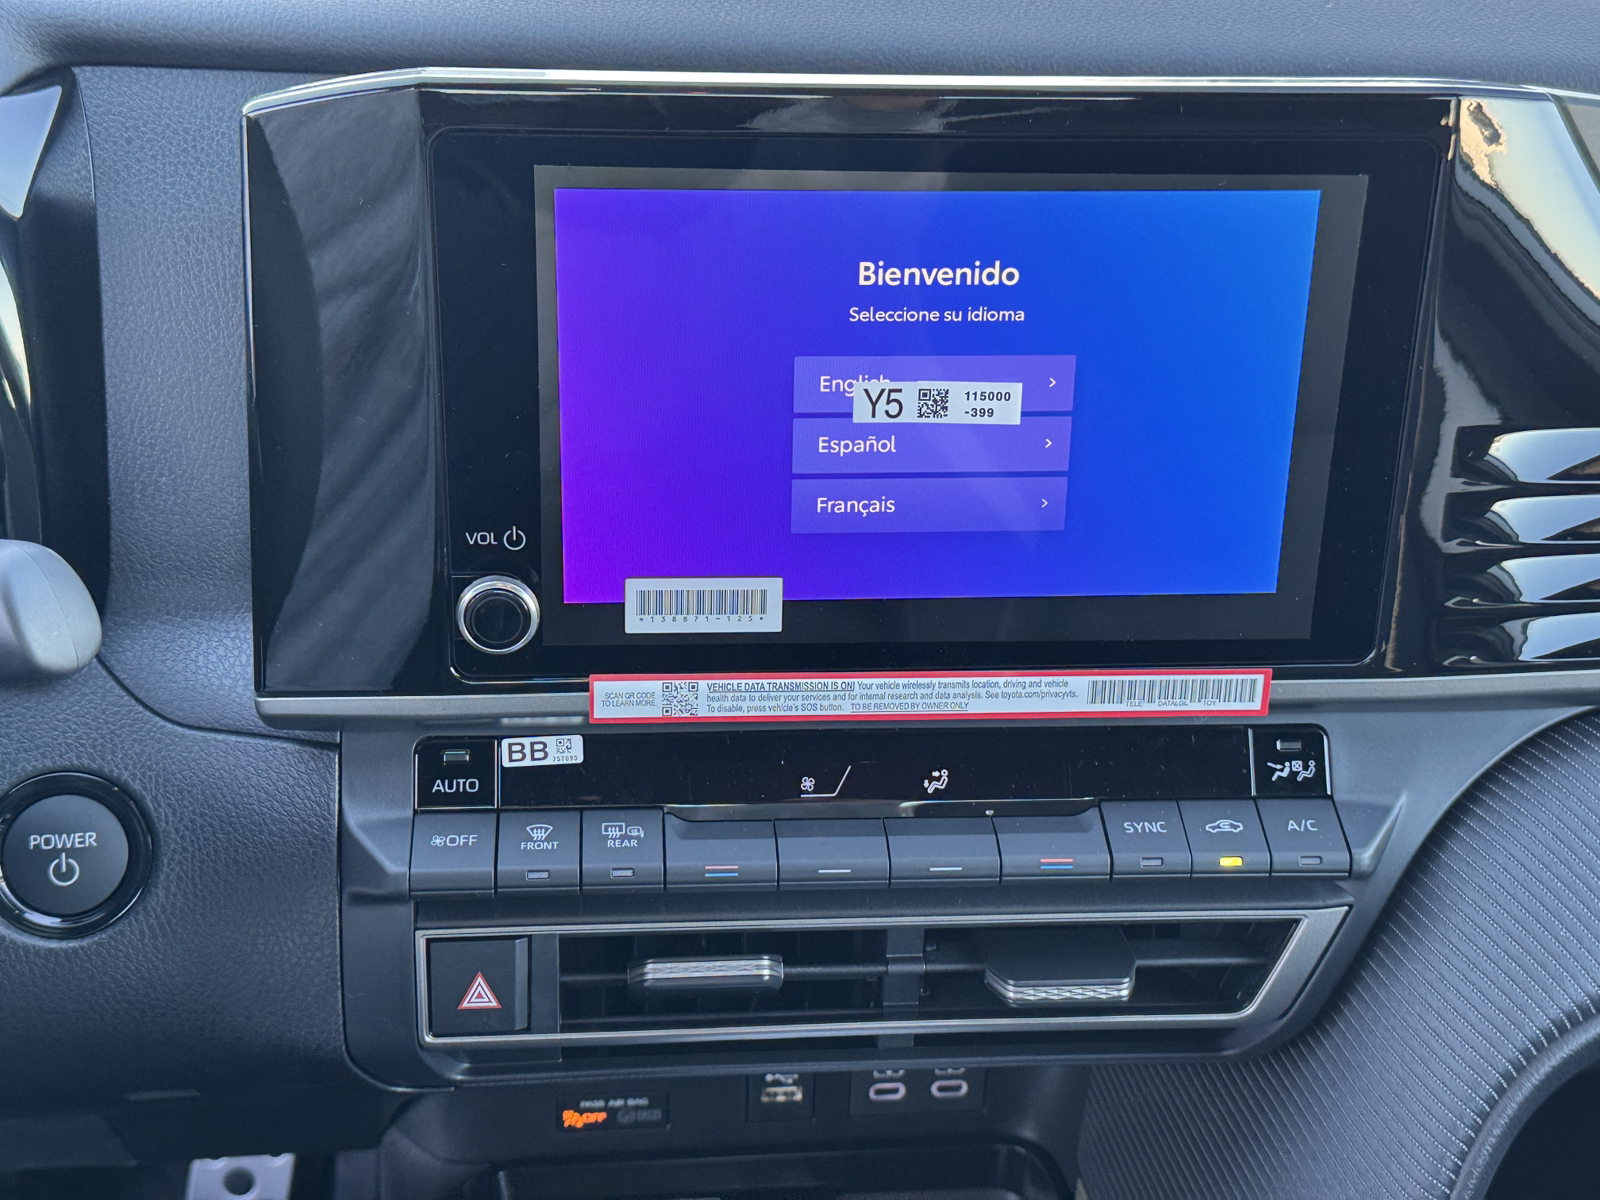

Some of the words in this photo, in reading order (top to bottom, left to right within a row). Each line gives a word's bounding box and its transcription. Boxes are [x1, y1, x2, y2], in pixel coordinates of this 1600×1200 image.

[858, 260, 1020, 286] Bienvenido
[848, 306, 940, 322] Seleccione
[943, 310, 962, 322] su
[967, 306, 1025, 322] idioma
[964, 391, 1012, 402] 115000
[863, 388, 904, 419] Y5
[964, 407, 995, 418] -399
[818, 435, 897, 457] Español
[816, 496, 896, 517] Français
[465, 532, 498, 545] VOL
[706, 682, 743, 692] VEHICLE
[744, 682, 766, 691] DATA
[766, 681, 829, 691] TRANSMISSION
[831, 681, 839, 690] IS
[857, 681, 874, 690] Your
[875, 680, 900, 690] vehicle
[902, 680, 937, 691] wirelessly
[937, 679, 970, 689] transmits
[971, 679, 1002, 690] location,
[1002, 679, 1027, 690] driving
[1028, 679, 1042, 688] and
[1044, 678, 1069, 688] vehicle
[604, 692, 624, 700] SCAN
[624, 692, 635, 700] QR
[706, 693, 729, 702] health
[730, 693, 747, 702] data
[748, 694, 756, 702] to
[758, 693, 781, 702] deliver
[783, 694, 800, 704] your
[801, 693, 831, 701] services
[832, 693, 846, 701] and
[847, 692, 858, 701] for
[860, 692, 886, 701] internal
[887, 691, 918, 700] research
[920, 691, 933, 700] and
[934, 691, 951, 699] data
[984, 690, 999, 699] See
[706, 704, 715, 713] To
[717, 703, 745, 714] disable,
[746, 705, 767, 714] press
[768, 703, 799, 712] vehicle's
[800, 703, 818, 711] SOS
[851, 703, 861, 711] TO
[873, 702, 910, 711] REMOVED
[910, 702, 921, 710] BY
[921, 702, 949, 710] OWNER
[949, 701, 970, 710] ONLY
[507, 741, 549, 763] BB
[432, 778, 479, 793] AUTO
[1124, 821, 1167, 834] SYNC
[1287, 820, 1318, 832] A/C
[29, 832, 97, 850] POWER
[446, 835, 478, 847] OFF
[520, 841, 559, 850] FRONT
[607, 839, 638, 848] REAR
